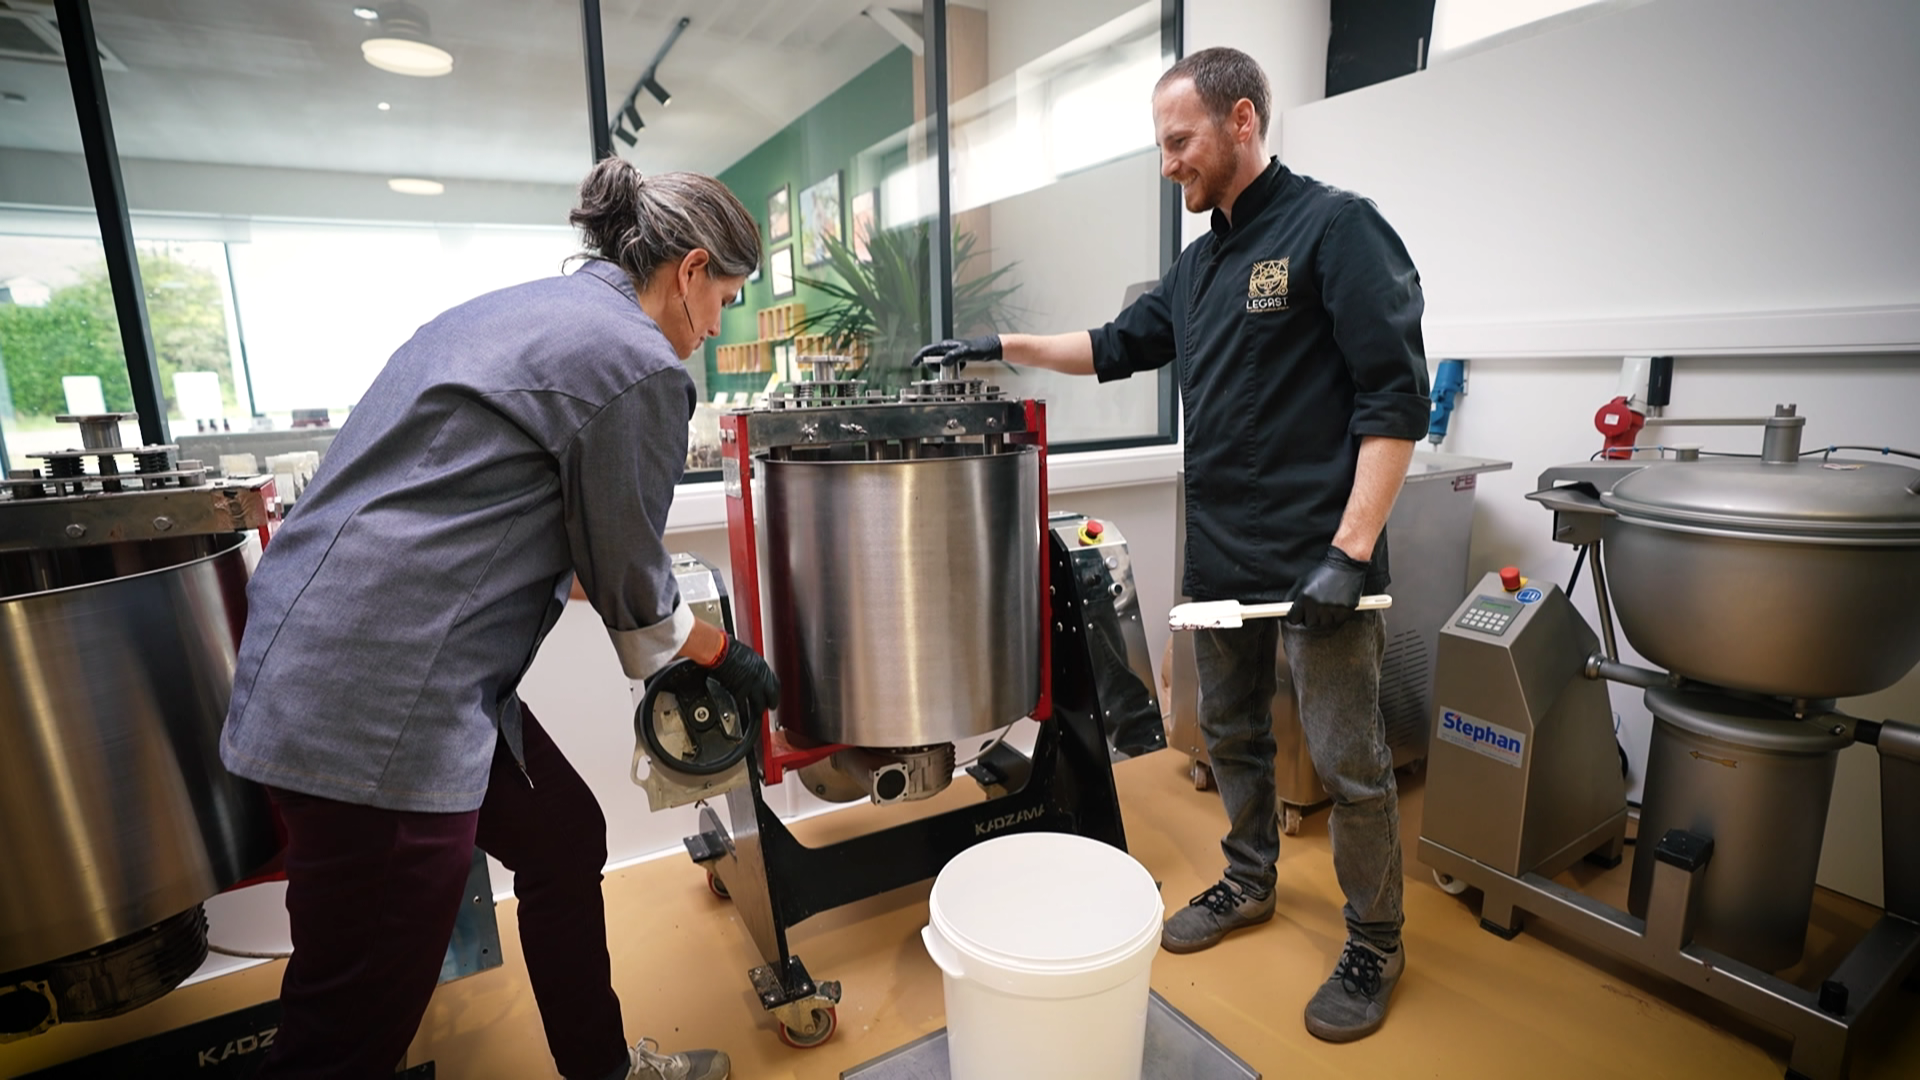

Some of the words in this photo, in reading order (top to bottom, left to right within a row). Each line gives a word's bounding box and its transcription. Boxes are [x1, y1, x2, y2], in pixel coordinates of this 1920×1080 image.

[1246, 297, 1288, 309] LEGAST
[1443, 712, 1521, 753] Stephan
[975, 804, 1045, 836] KADZAMA
[198, 1027, 279, 1068] KADZ
